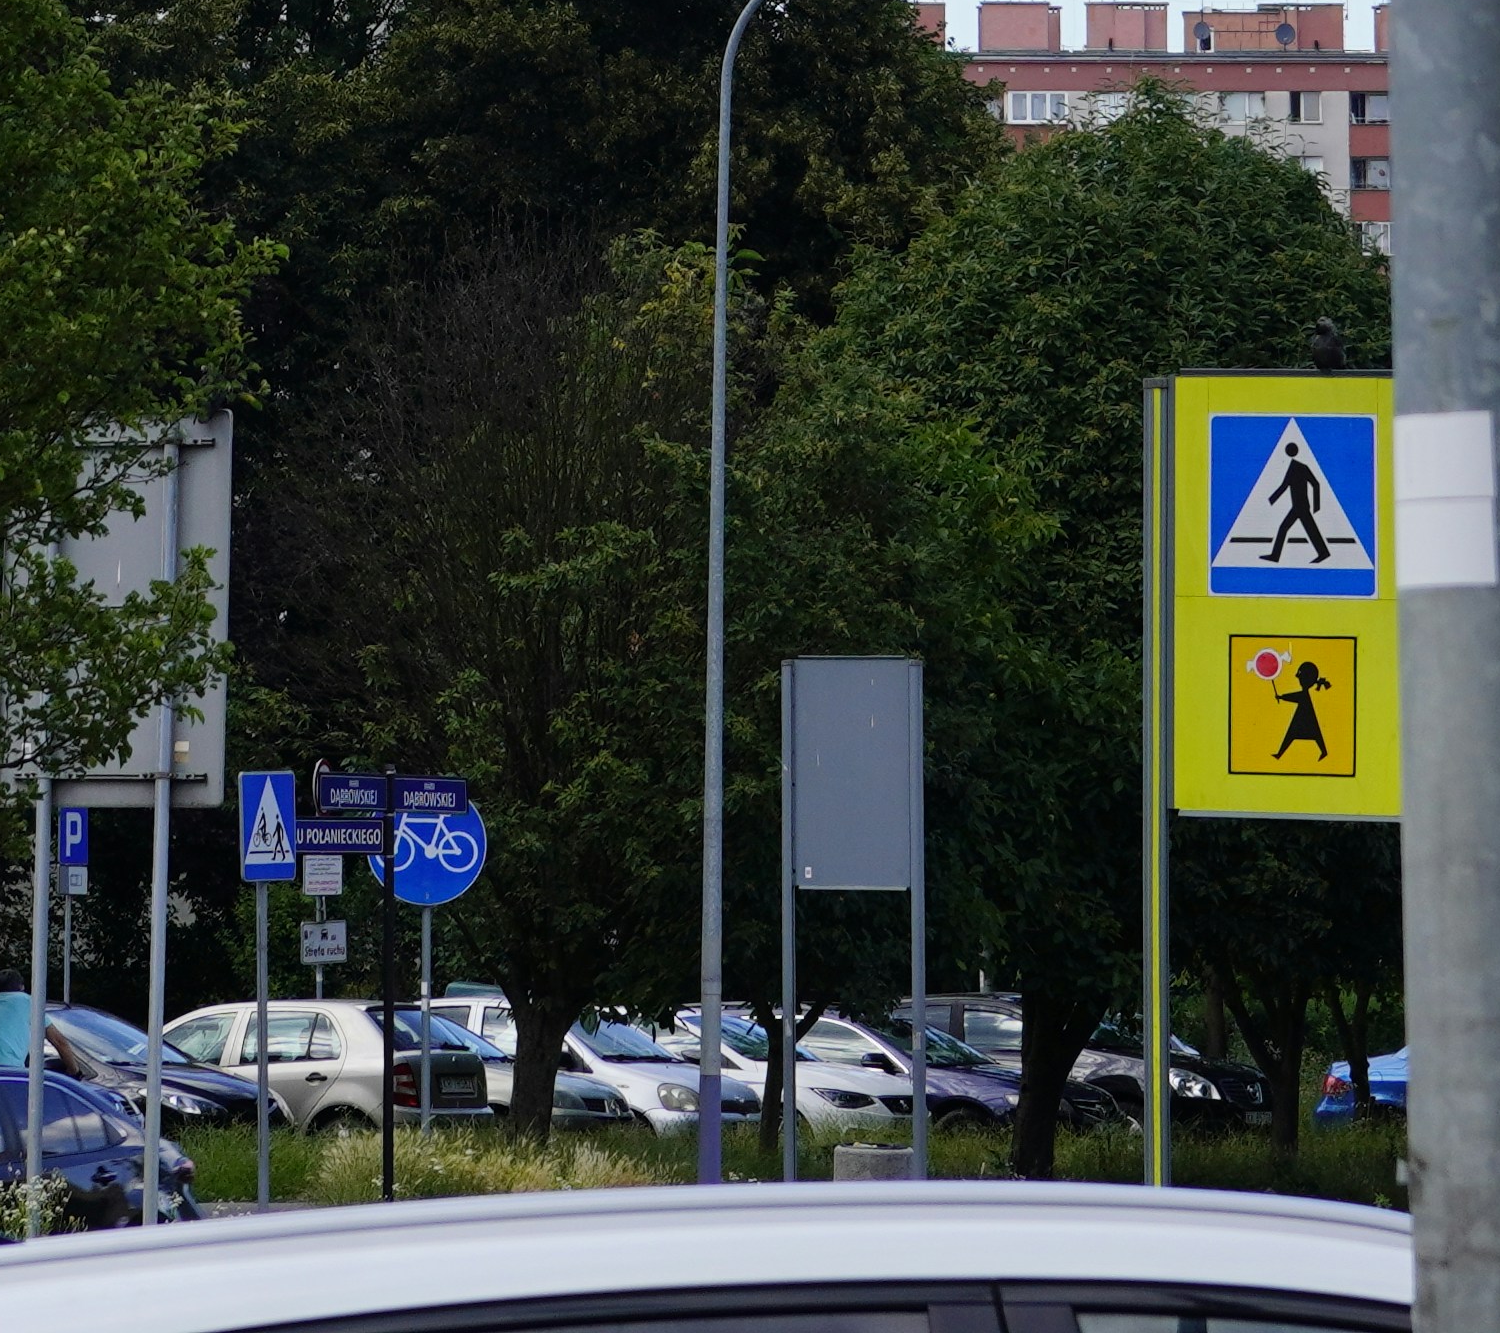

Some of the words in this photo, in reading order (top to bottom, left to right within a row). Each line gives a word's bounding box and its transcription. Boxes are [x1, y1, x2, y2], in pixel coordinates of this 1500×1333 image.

[403, 791, 456, 809] DĄBROWSKIEJ
[65, 812, 82, 857] P
[306, 828, 381, 846] POŁANIECKIEGO
